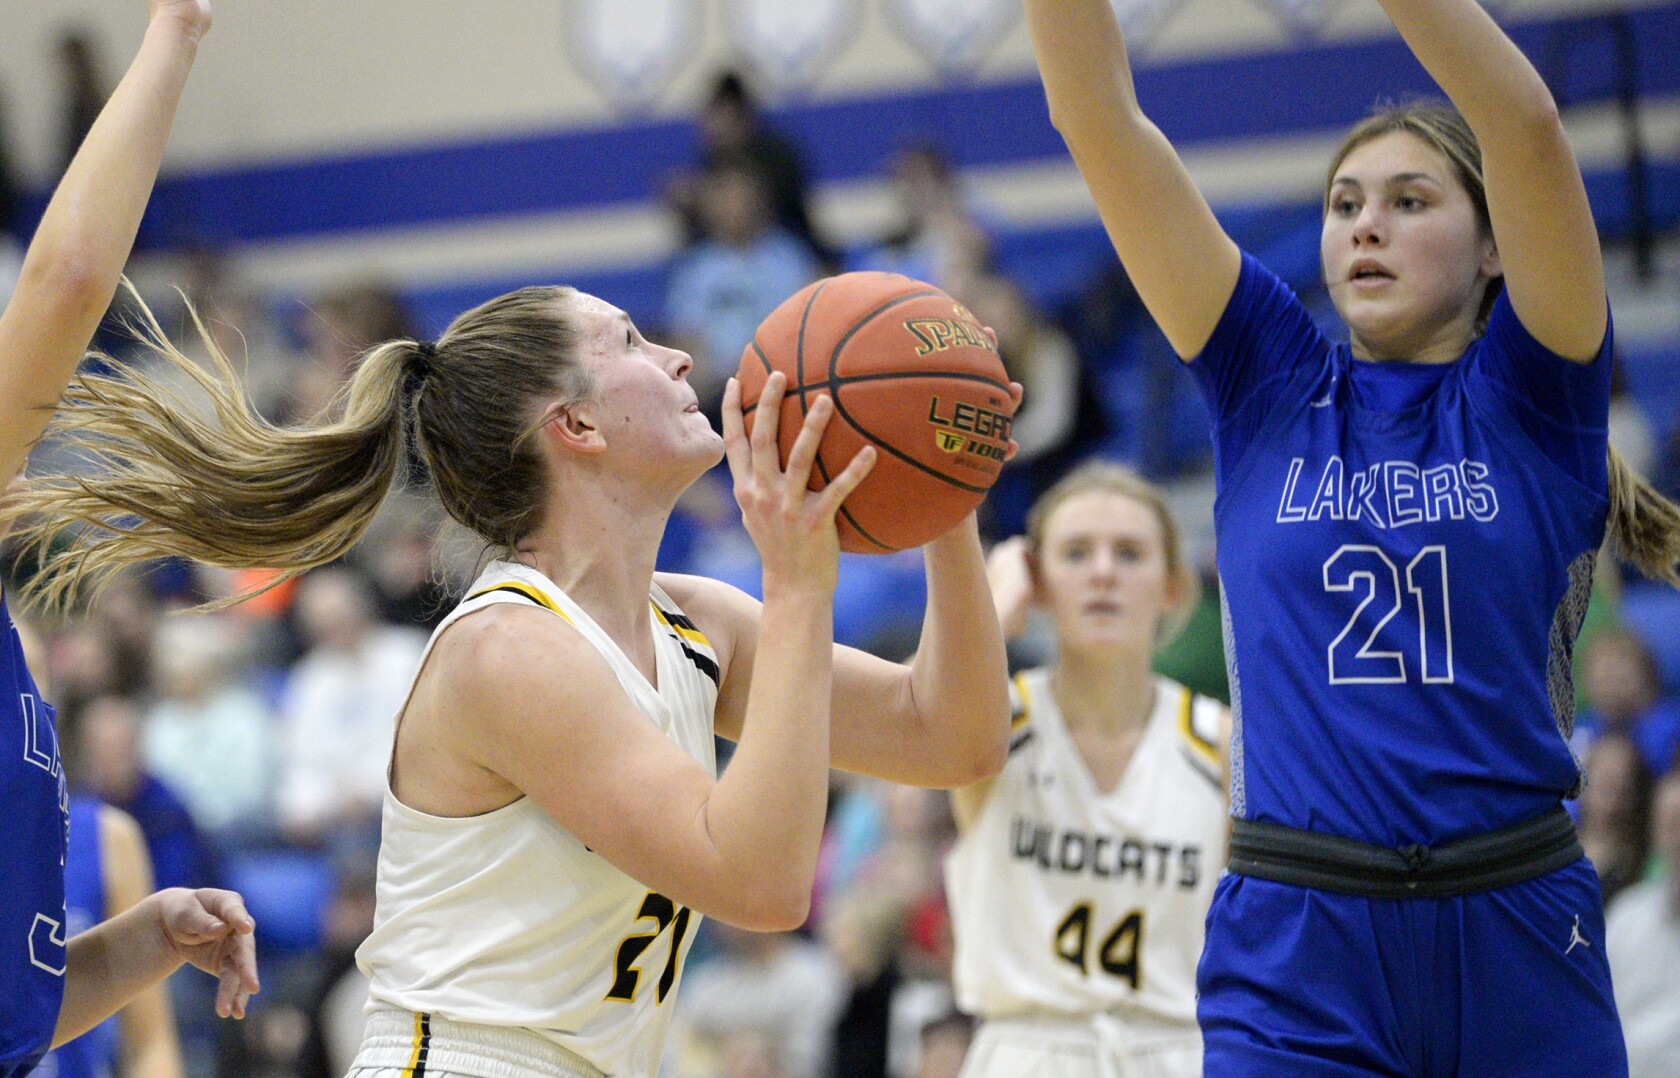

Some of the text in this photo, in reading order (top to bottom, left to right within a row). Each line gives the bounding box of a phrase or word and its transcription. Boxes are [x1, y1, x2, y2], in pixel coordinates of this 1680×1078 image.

[1276, 454, 1500, 529] LAKERS
[1322, 544, 1454, 686] 21
[603, 888, 693, 1007] 21
[1054, 897, 1146, 993] 44
